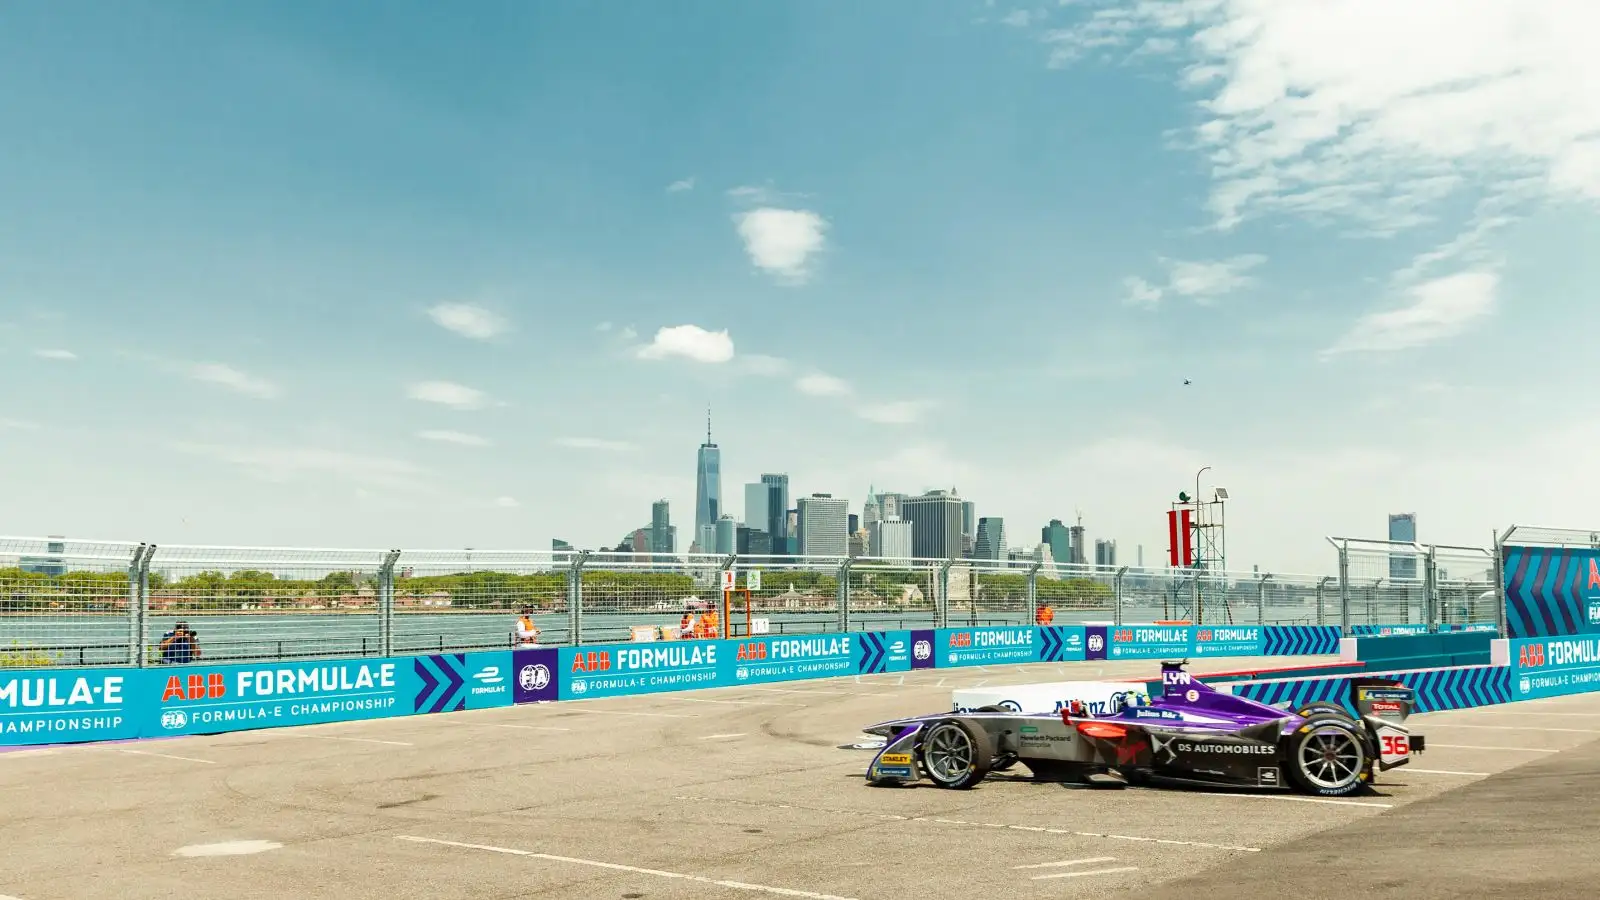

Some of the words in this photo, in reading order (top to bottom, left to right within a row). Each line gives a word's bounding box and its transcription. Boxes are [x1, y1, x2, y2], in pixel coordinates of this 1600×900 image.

[949, 632, 971, 648] ABB
[974, 630, 1033, 647] FORMULA-E
[1088, 637, 1104, 650] FIA
[1113, 630, 1133, 643] ABB
[1136, 629, 1188, 642] FORMULA-E
[1196, 630, 1213, 641] ABB
[1214, 629, 1258, 641] FORMULA-E
[736, 642, 767, 661] ABB
[771, 637, 850, 659] FORMULA-E
[1519, 643, 1545, 668] ABB
[571, 651, 611, 673] ABB
[617, 645, 717, 670] FORMULA-E
[519, 666, 550, 687] FIA
[750, 665, 794, 677] FORMULA-E
[798, 661, 850, 673] CHAMPIONSHIP
[161, 673, 227, 702] ABB
[237, 663, 396, 697] FORMULA-E
[590, 679, 646, 690] FORMULA-E
[651, 672, 717, 686] CHAMPIONSHIP
[1163, 672, 1191, 685] LYN
[472, 685, 505, 694] FORMULA-E
[162, 713, 187, 728] FIA
[192, 705, 282, 724] FORMULA-E
[291, 698, 395, 716] CHAMPIONSHIP
[0, 716, 123, 733] AMPIONSHIP
[1178, 743, 1192, 752] DS
[1194, 744, 1276, 755] AUTOMOBILES
[1381, 736, 1409, 755] 36
